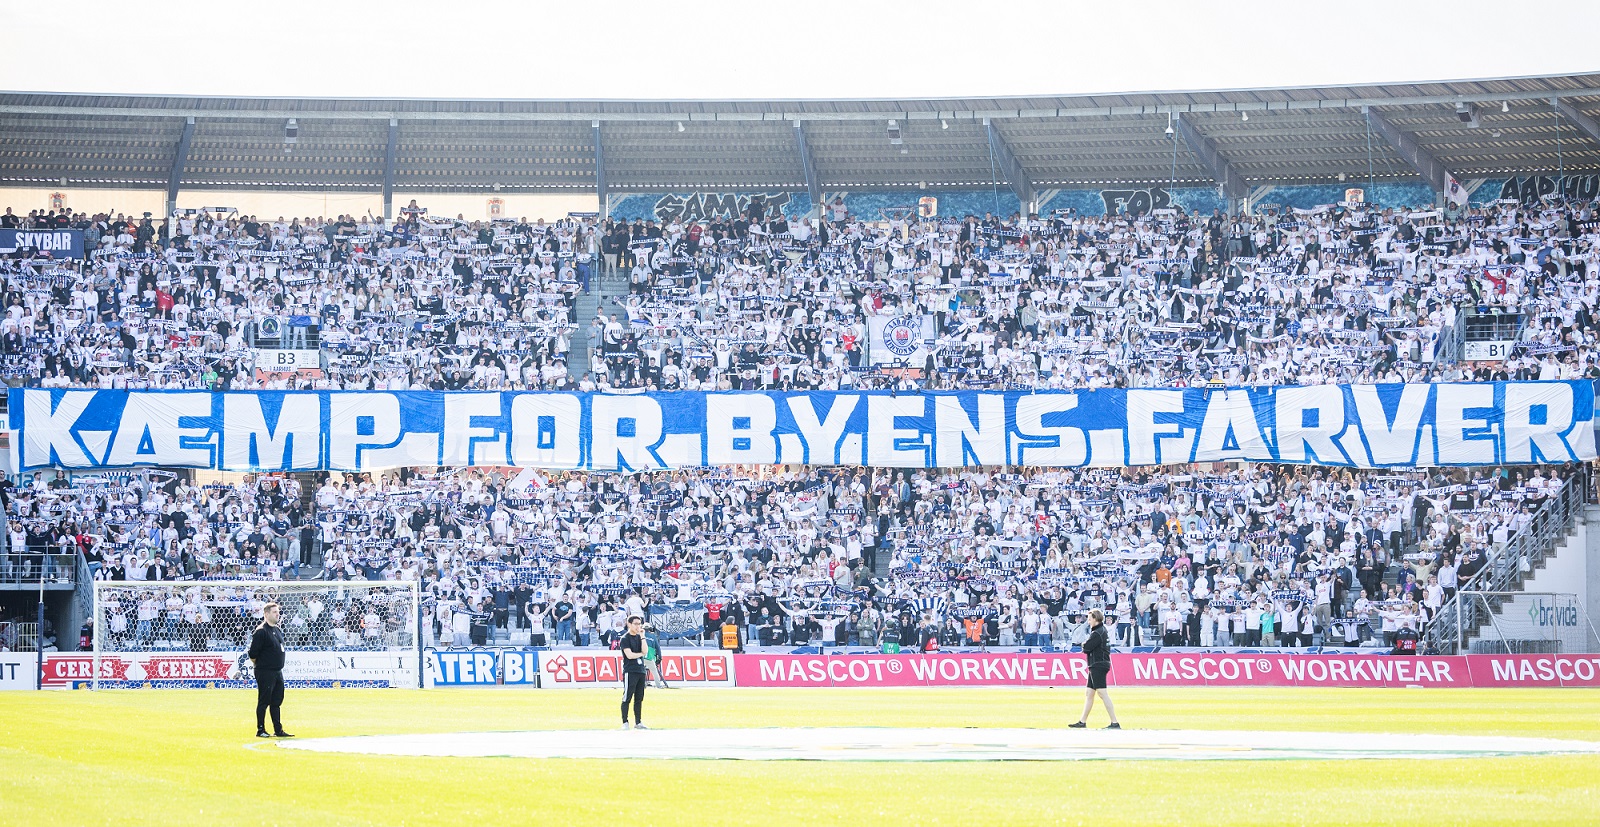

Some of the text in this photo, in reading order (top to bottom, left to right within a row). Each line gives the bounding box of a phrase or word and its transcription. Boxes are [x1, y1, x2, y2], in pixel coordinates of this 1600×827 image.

[655, 190, 791, 222] SAMLT
[15, 232, 72, 251] SKYBAR
[277, 352, 296, 365] B3
[1489, 344, 1505, 357] B1
[23, 379, 1581, 469] KÆMP FOR BYENS FARVER
[1539, 599, 1577, 627] bravida
[0, 663, 21, 680] T
[55, 661, 114, 678] CERS
[157, 661, 217, 678] CERES
[576, 658, 725, 678] BAAUS
[758, 658, 1088, 682] MASCOT® WORKWEAR
[1132, 656, 1454, 683] MASCOT® WORKWEAR
